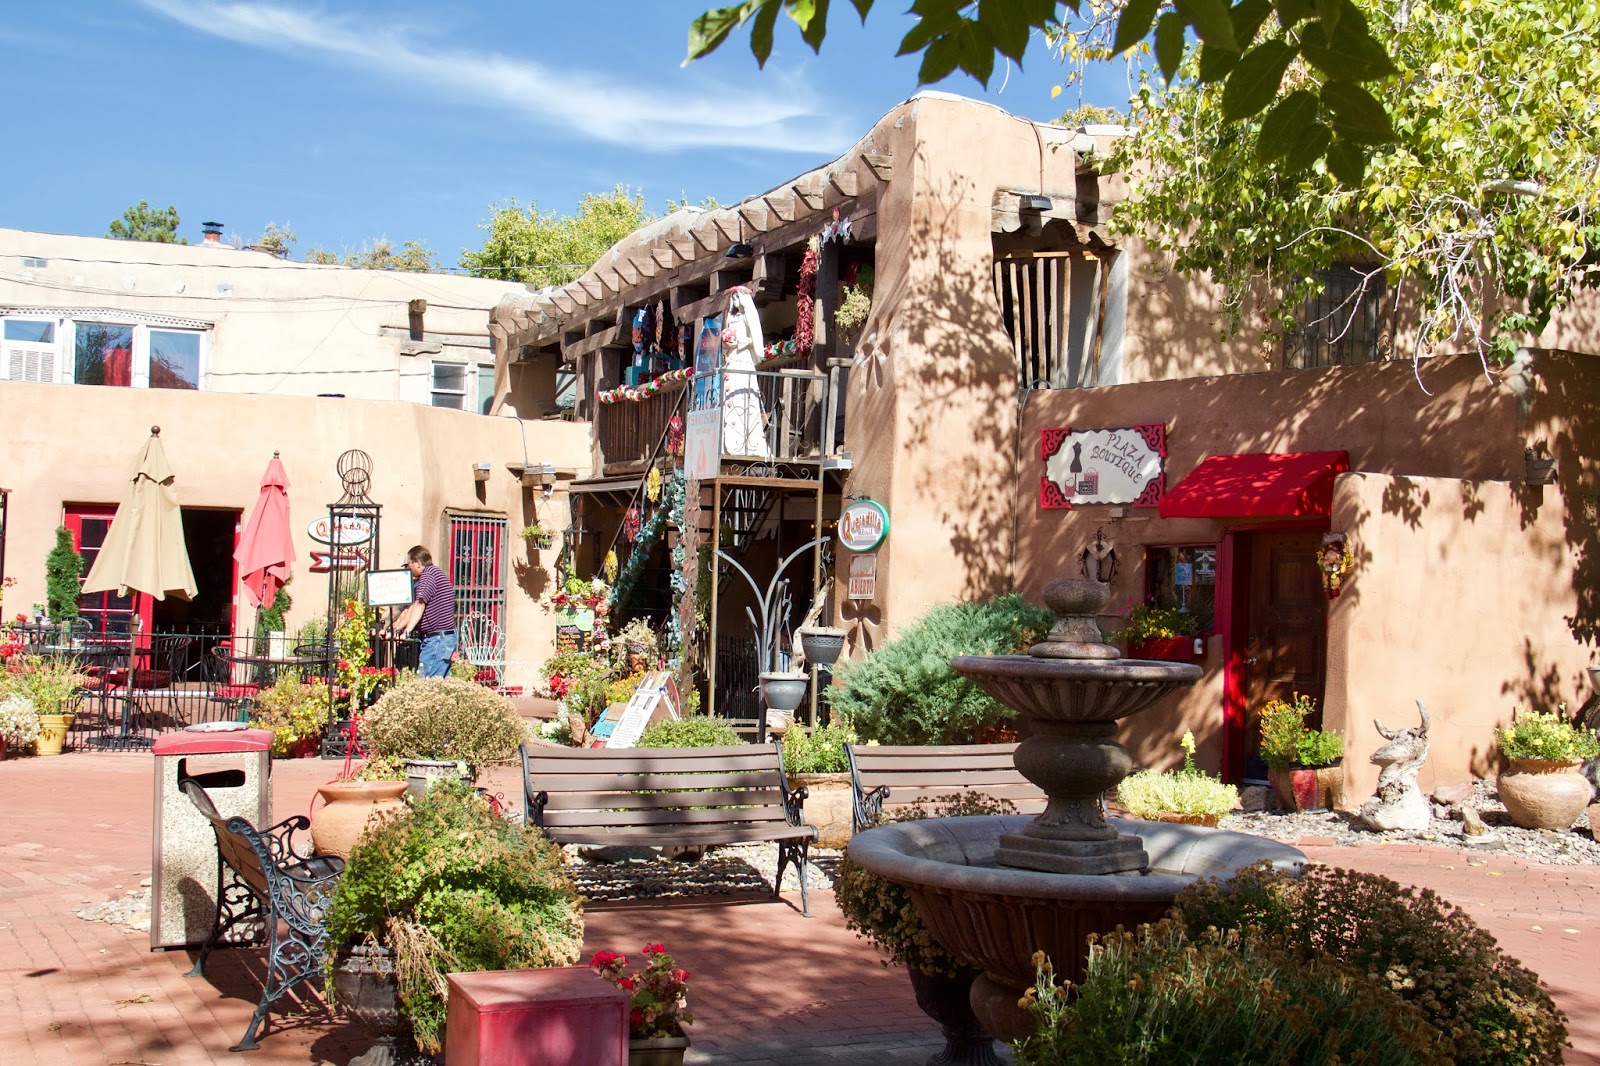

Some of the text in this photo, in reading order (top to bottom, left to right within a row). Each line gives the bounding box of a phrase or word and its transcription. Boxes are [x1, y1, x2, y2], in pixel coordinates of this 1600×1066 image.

[1090, 445, 1143, 483] BOUTIQUE
[1105, 433, 1145, 468] PLAZA
[850, 579, 873, 595] ABIERTO
